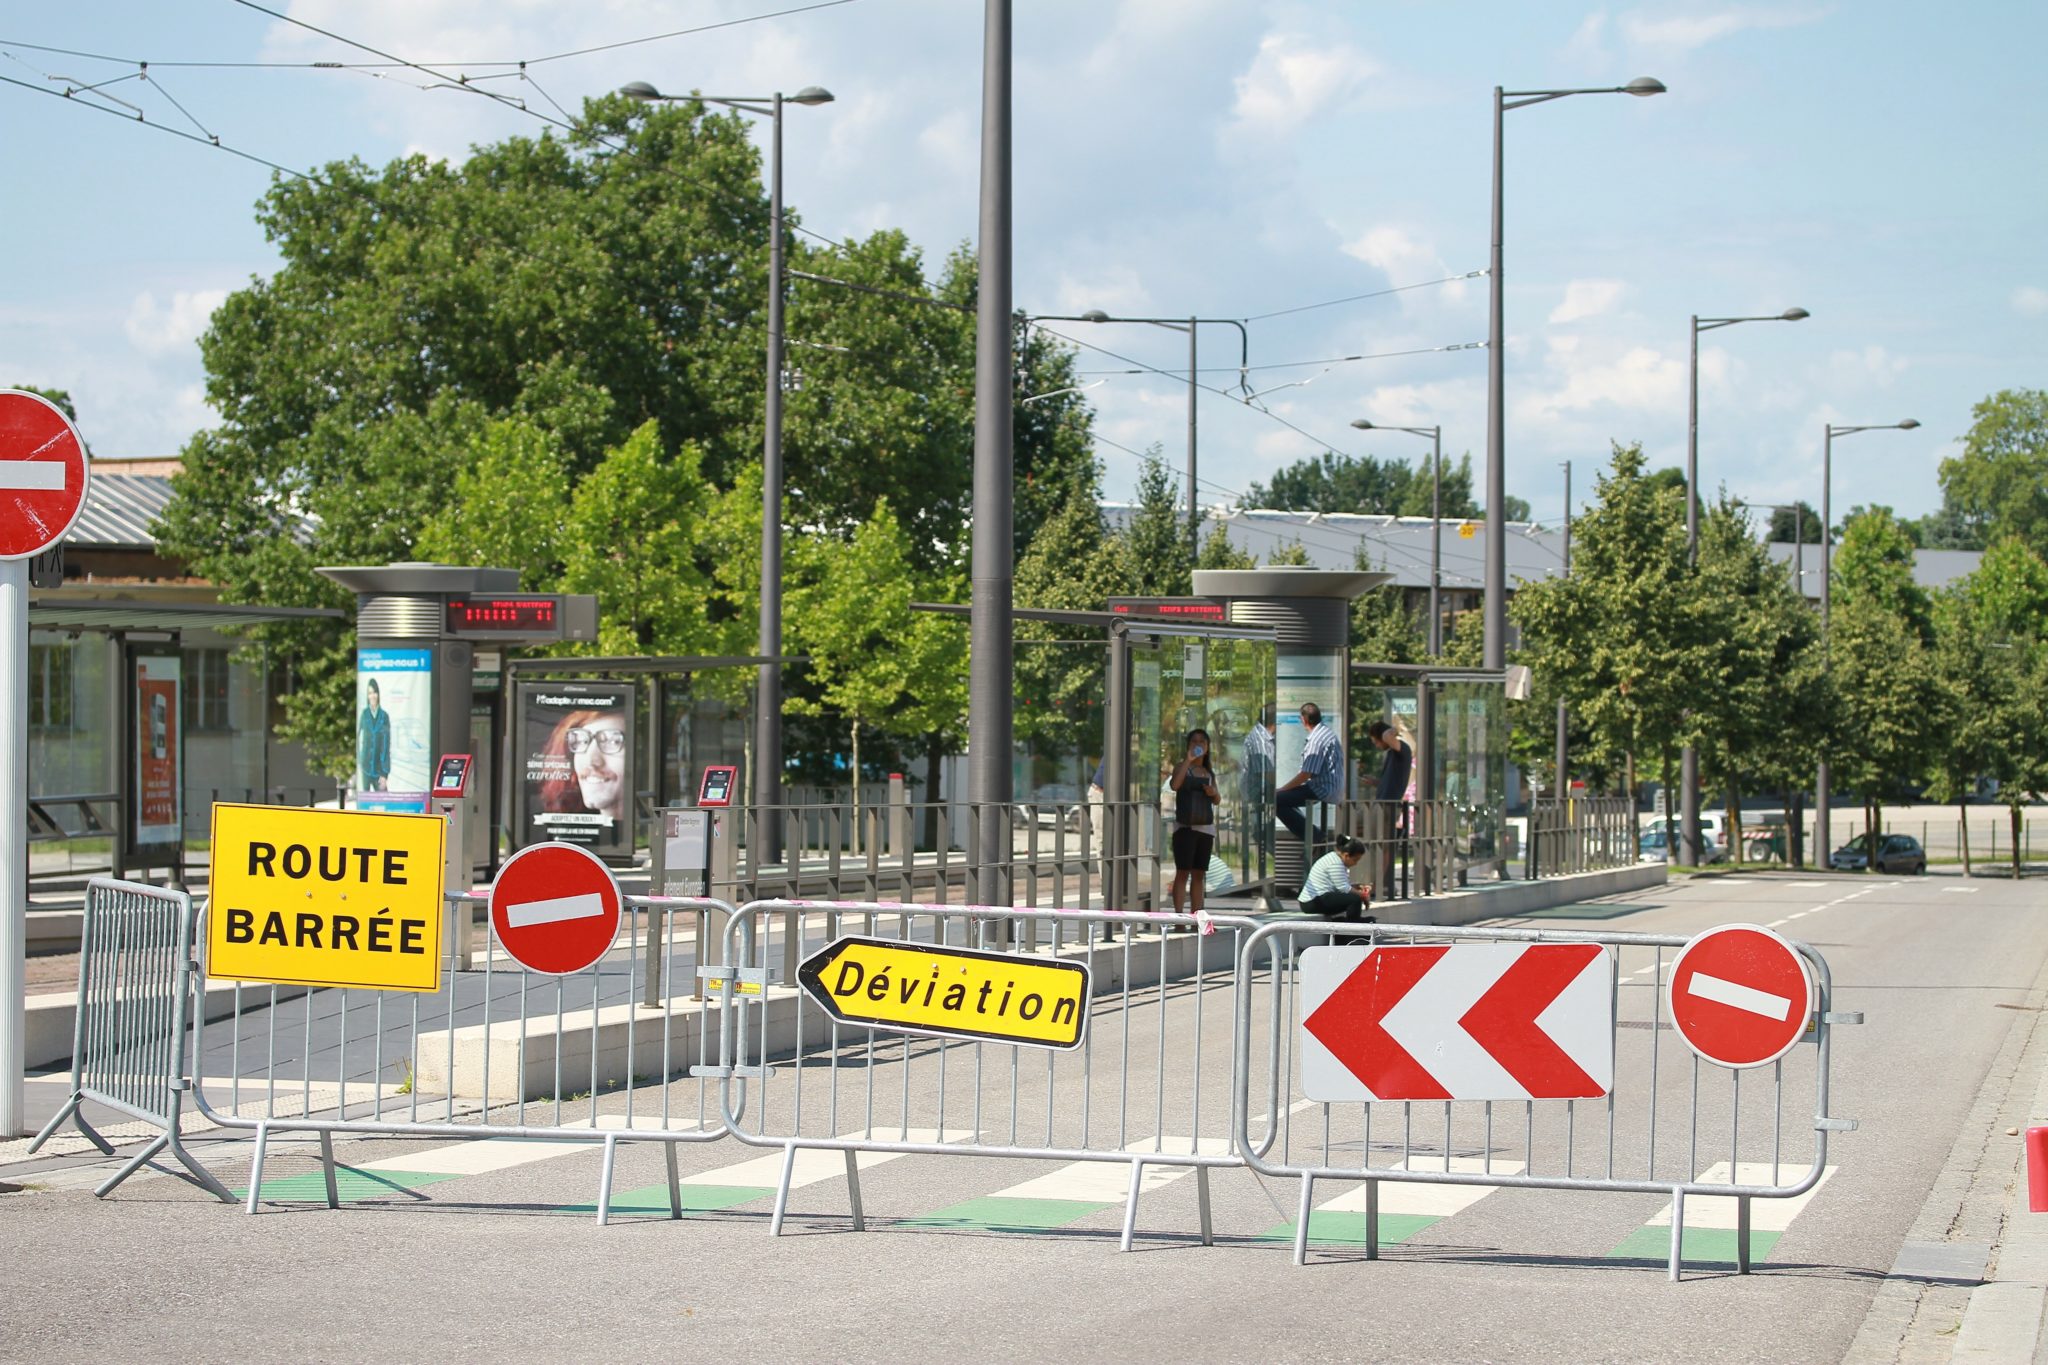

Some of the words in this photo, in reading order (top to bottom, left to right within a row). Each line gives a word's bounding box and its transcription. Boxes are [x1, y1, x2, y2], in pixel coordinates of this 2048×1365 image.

[248, 842, 408, 885] ROUTE
[664, 876, 685, 896] arlement
[226, 907, 426, 955] BARRÉE
[834, 960, 1076, 1025] Déviation
